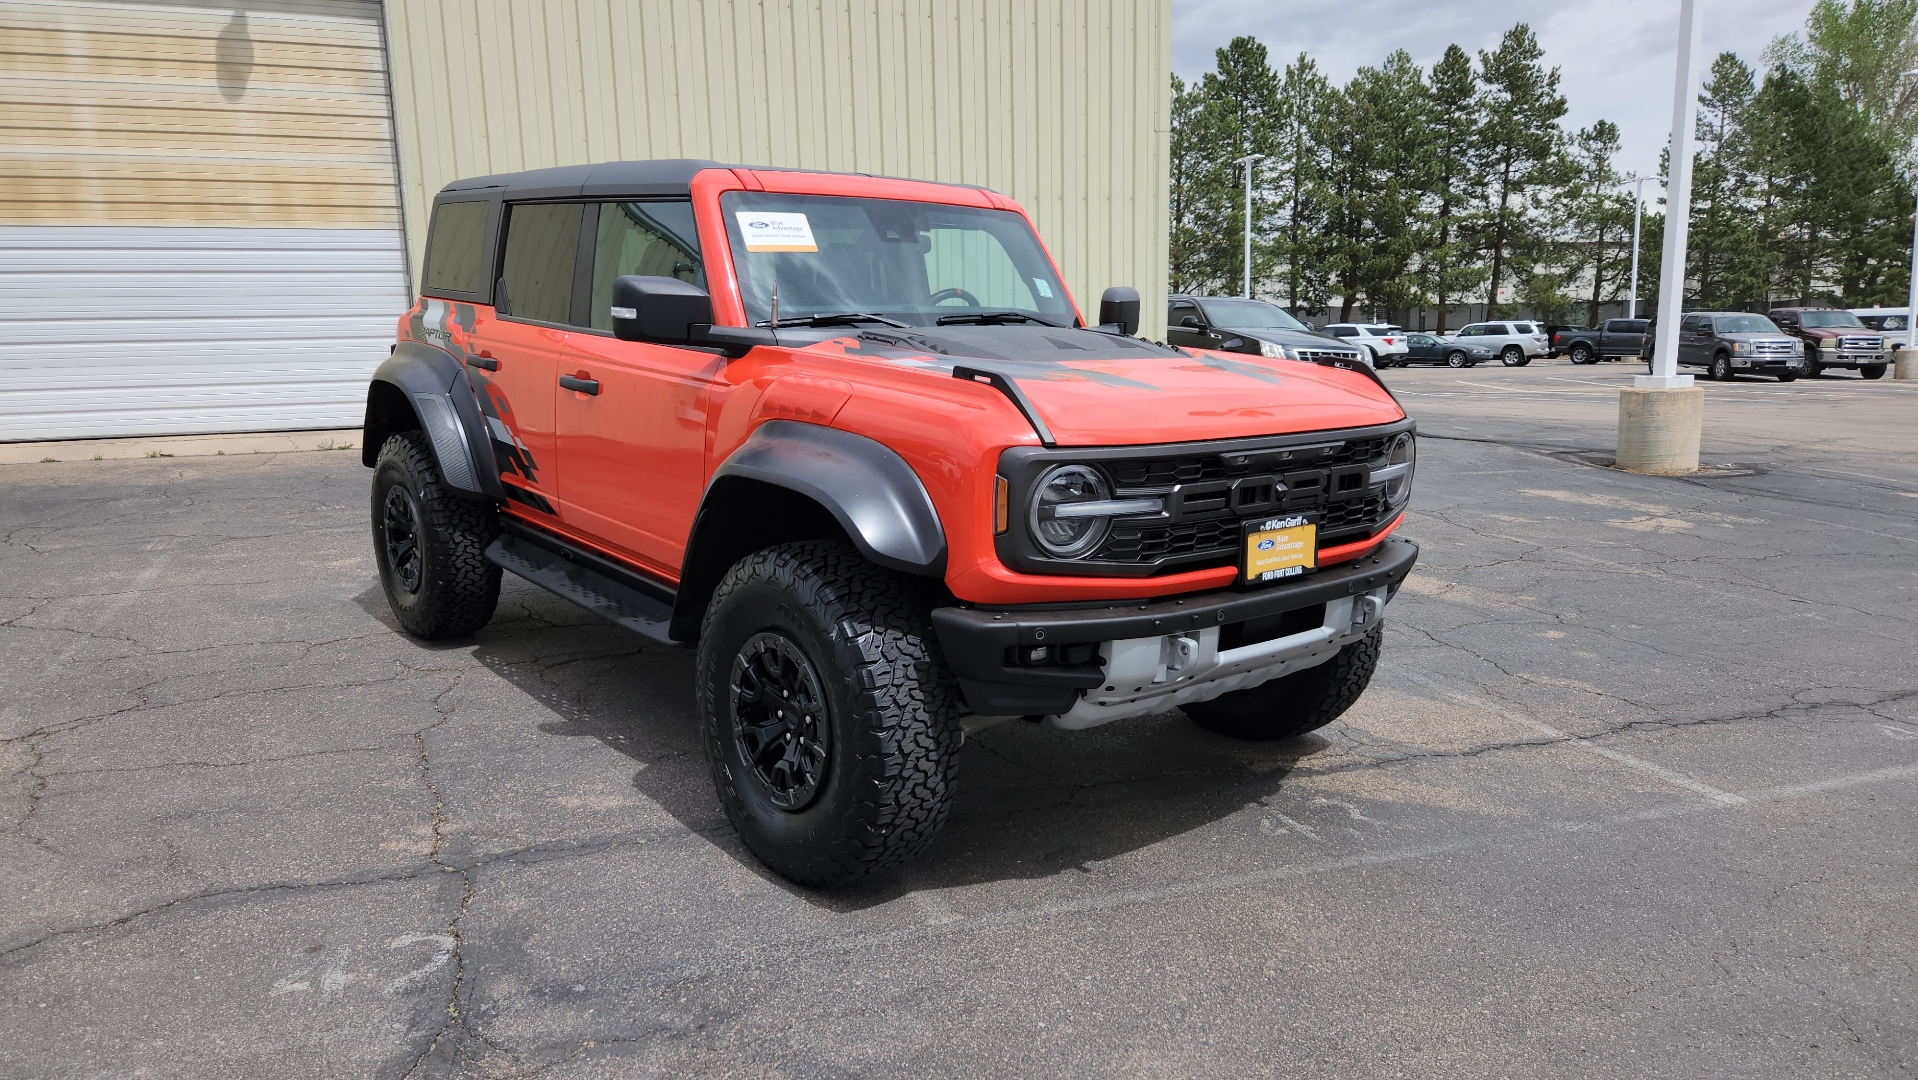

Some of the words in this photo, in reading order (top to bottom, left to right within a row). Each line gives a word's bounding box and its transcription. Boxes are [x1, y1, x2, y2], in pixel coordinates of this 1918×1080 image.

[420, 326, 453, 344] RAPTOR
[1172, 464, 1371, 523] FORD
[1271, 519, 1285, 530] Ken
[1285, 516, 1302, 527] Garff
[1258, 540, 1274, 550] Ford
[1276, 541, 1304, 551] Advantage
[1262, 570, 1274, 581] FORD
[1274, 568, 1285, 579] FORT
[1285, 565, 1303, 577] COLLINS
